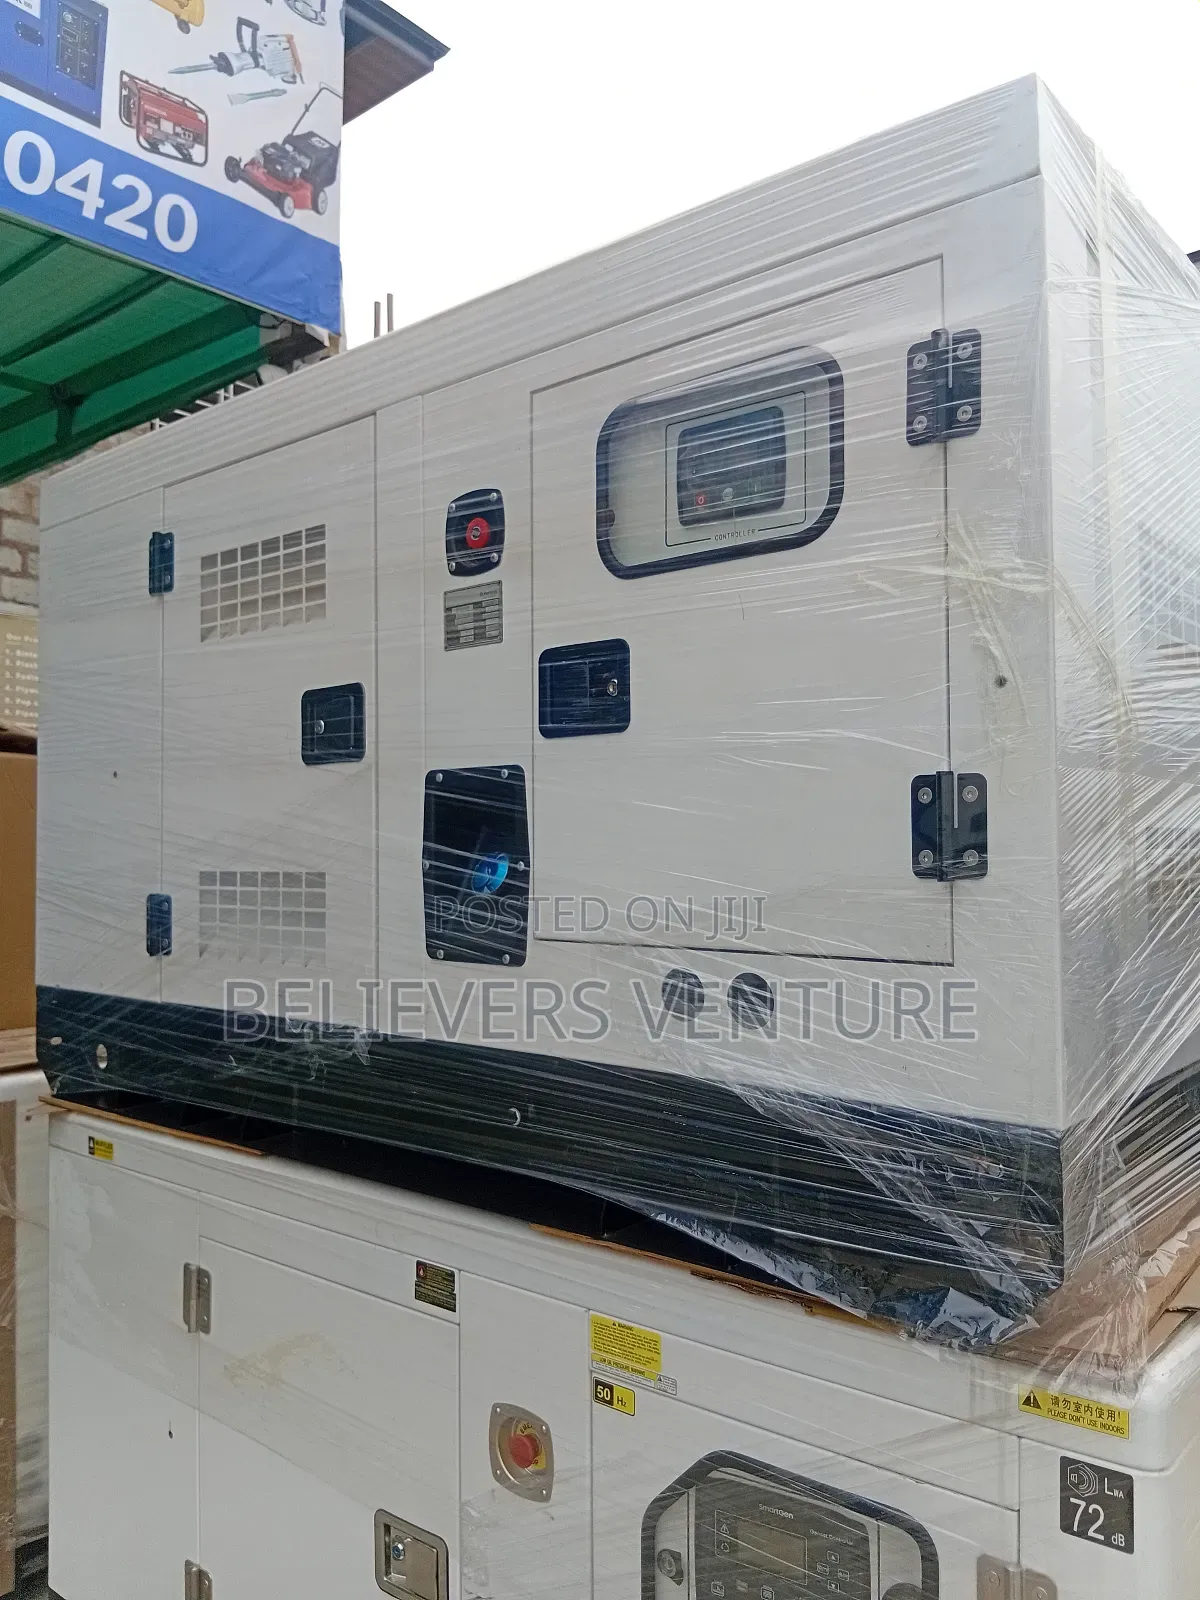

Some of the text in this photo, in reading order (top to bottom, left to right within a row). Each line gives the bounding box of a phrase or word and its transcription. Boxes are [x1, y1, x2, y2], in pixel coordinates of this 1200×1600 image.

[4, 130, 198, 253] 0420
[714, 528, 755, 541] CONTROLLER
[596, 1385, 627, 1408] 50 Hz
[1047, 1407, 1125, 1435] PLEASE DON'T USE INDOORS
[1069, 1497, 1105, 1541] 72
[1111, 1532, 1126, 1547] dB
